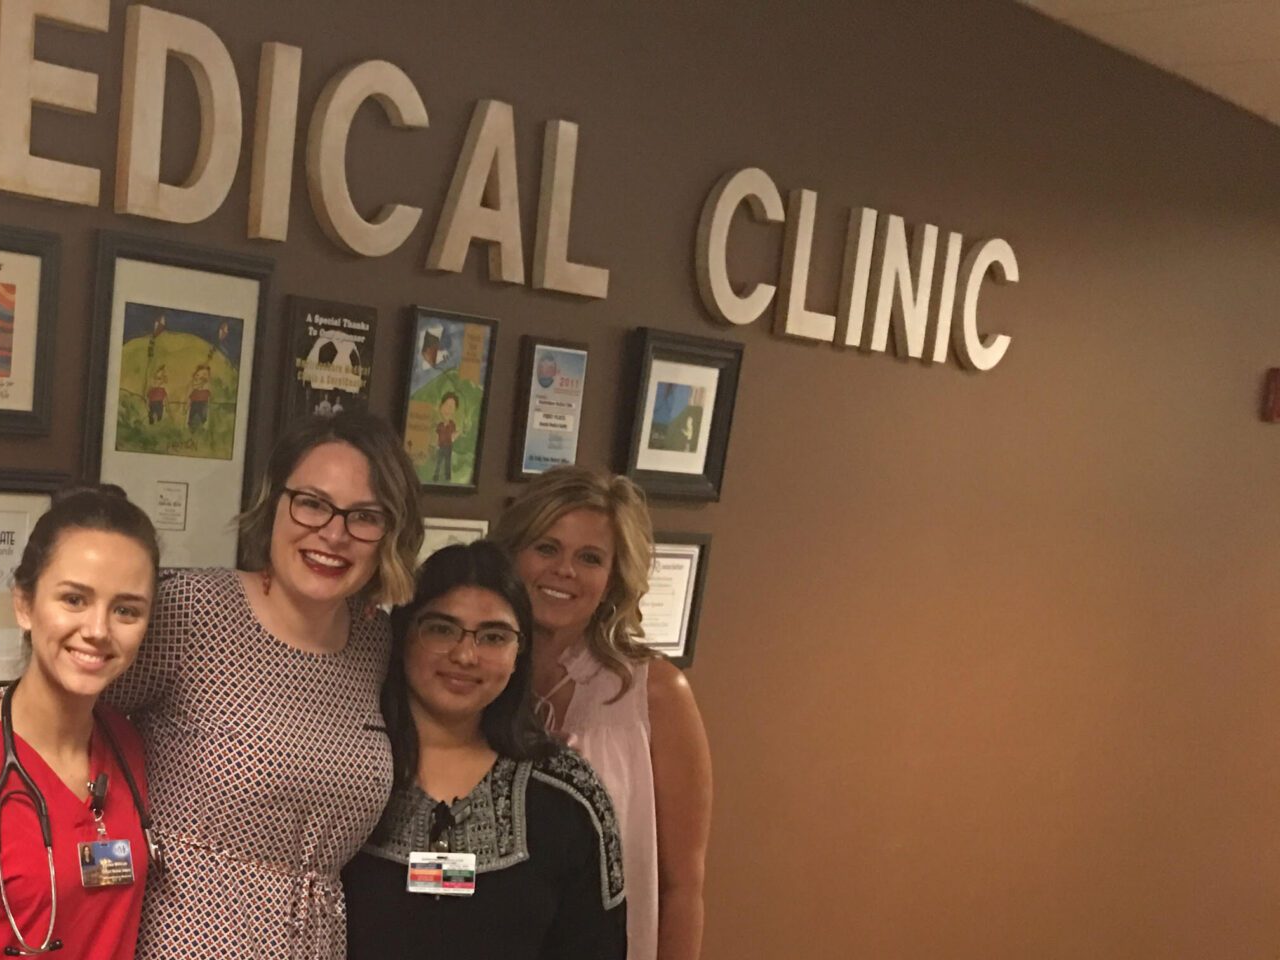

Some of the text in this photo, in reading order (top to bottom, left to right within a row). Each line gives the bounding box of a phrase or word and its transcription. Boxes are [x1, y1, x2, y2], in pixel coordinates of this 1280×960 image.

[696, 167, 1019, 371] CLINIC
[306, 313, 370, 331] A Special Thanks
[308, 326, 318, 336] To
[559, 377, 580, 388] 2011
